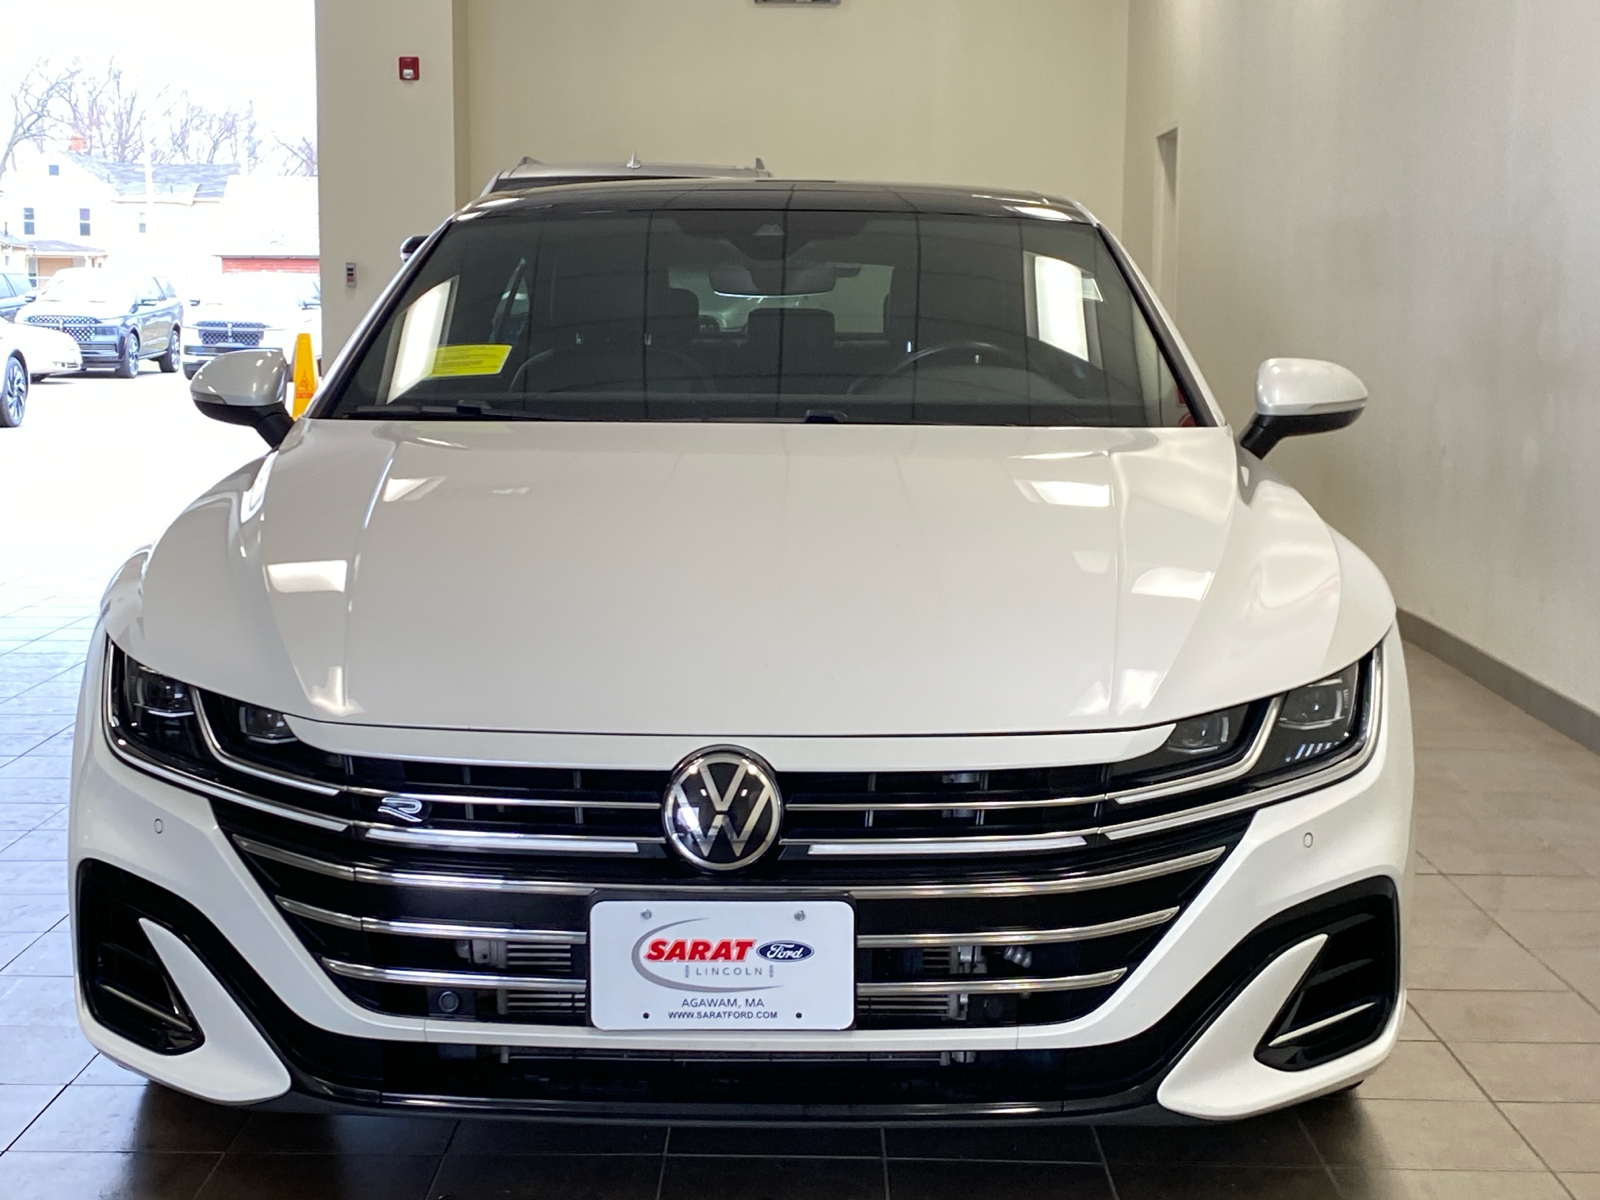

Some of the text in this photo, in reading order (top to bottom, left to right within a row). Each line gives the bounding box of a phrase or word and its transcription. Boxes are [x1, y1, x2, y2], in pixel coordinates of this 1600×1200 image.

[644, 938, 805, 962] SARAT Ford
[696, 967, 762, 976] LINCOLN
[681, 998, 765, 1009] AGAWAM, MA
[668, 1011, 778, 1019] WWW.SARATFORD.COM
